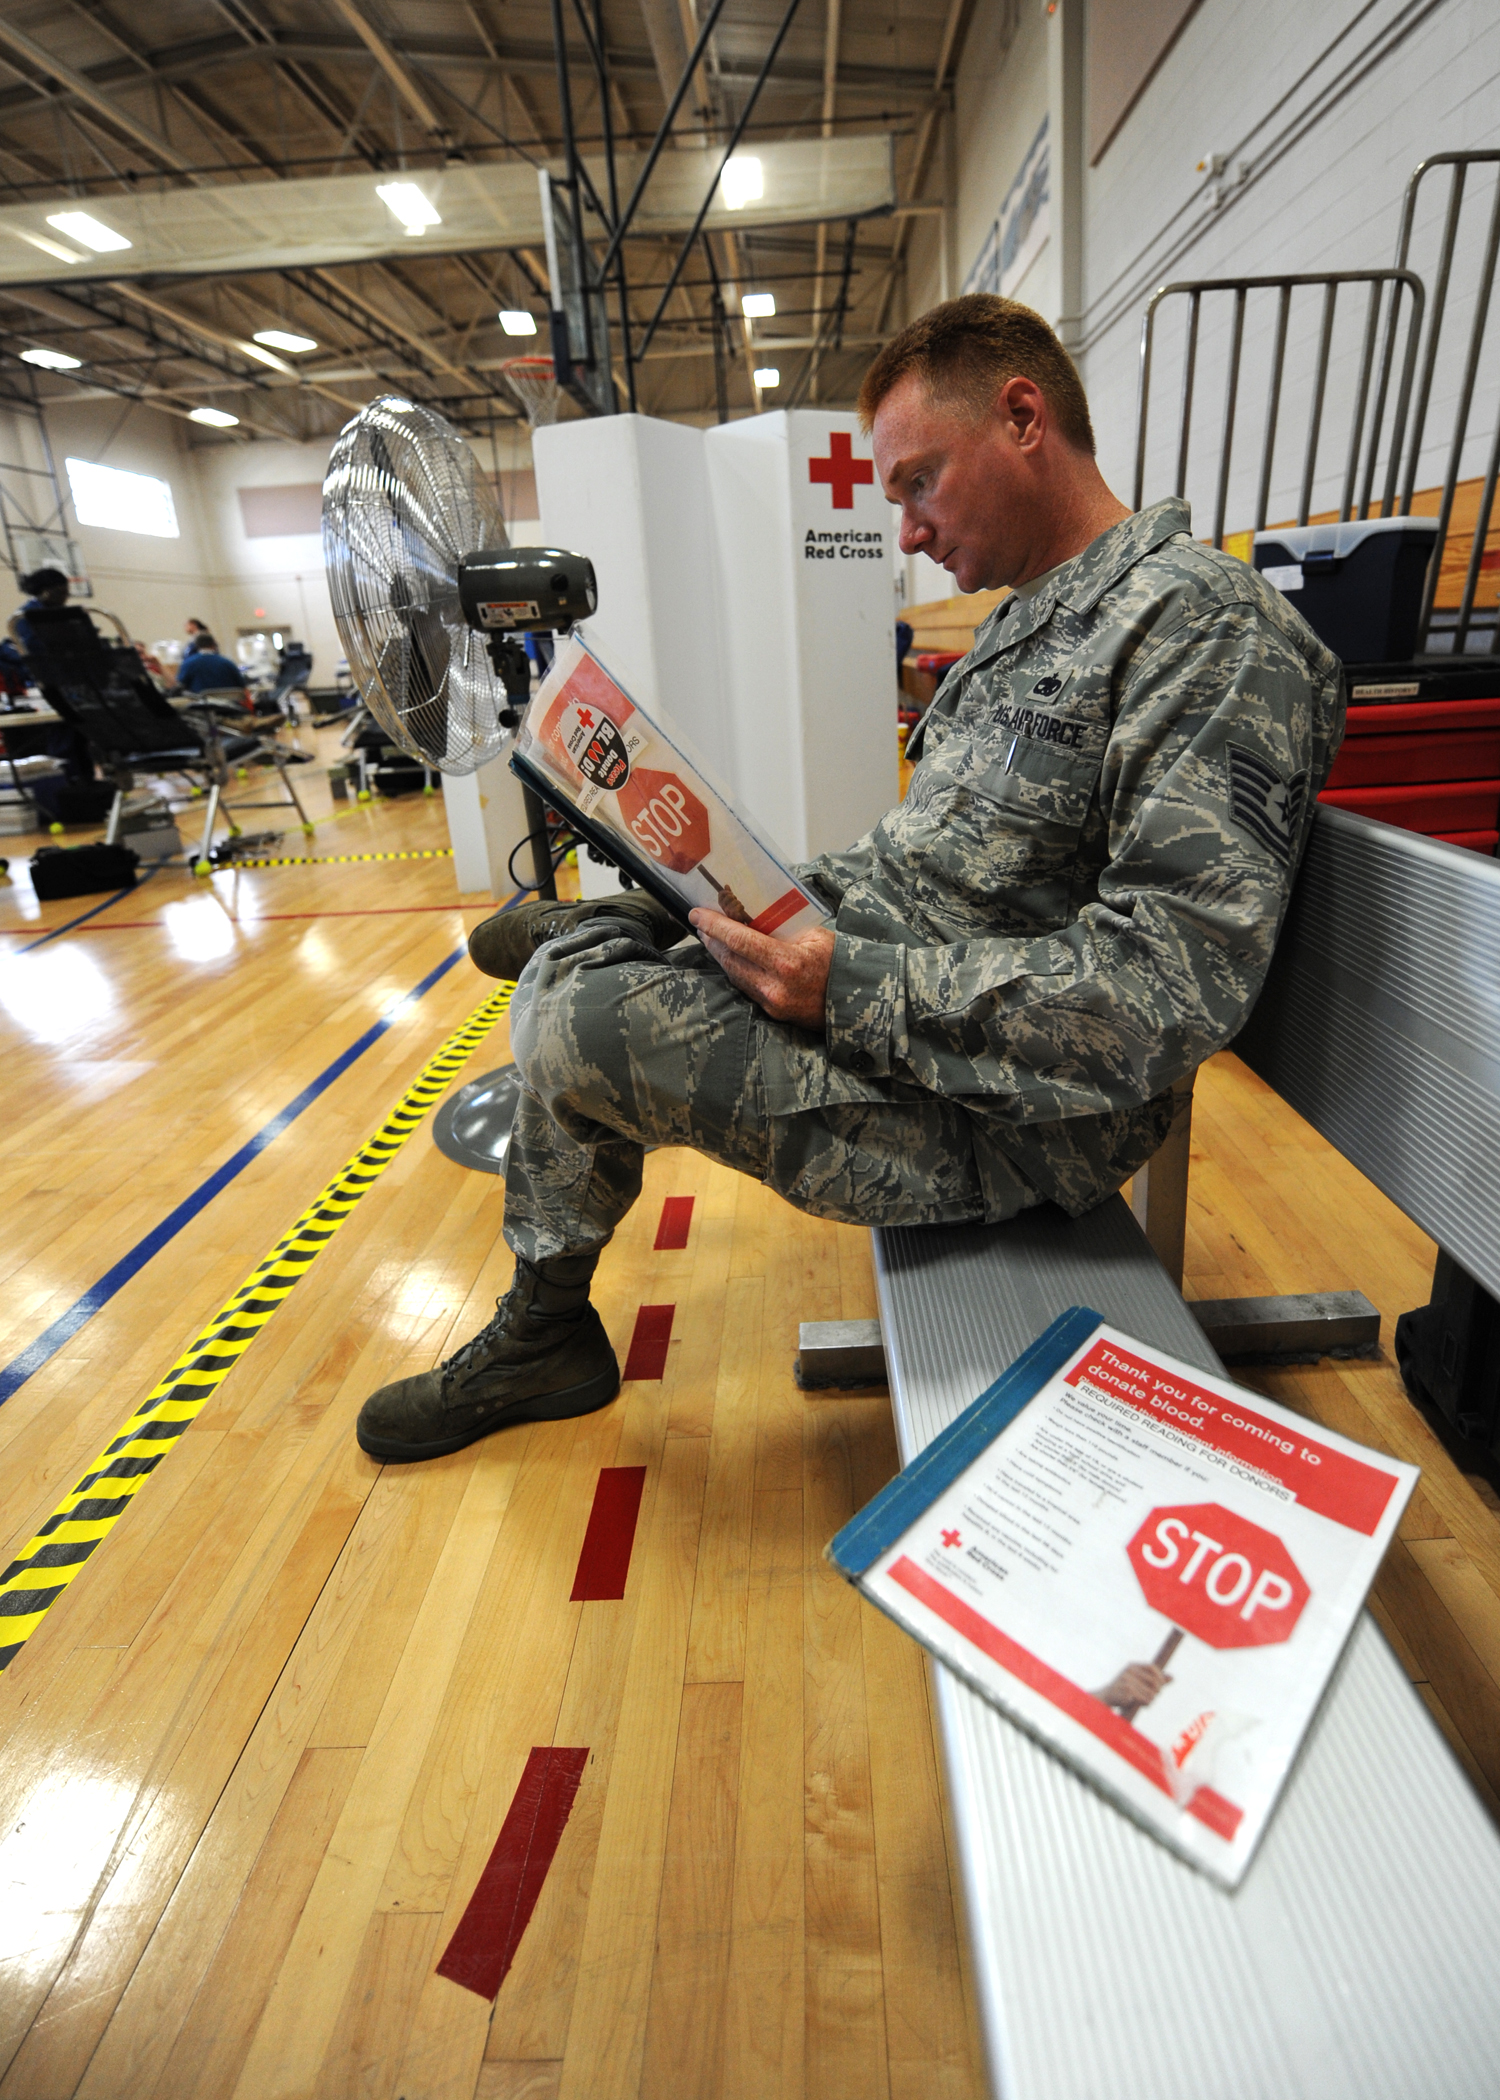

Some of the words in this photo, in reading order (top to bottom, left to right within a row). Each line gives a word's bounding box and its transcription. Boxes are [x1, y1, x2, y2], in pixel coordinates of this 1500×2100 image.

[804, 545, 835, 559] Red
[840, 545, 883, 559] Cross
[805, 529, 882, 543] American
[572, 732, 586, 754] American
[1007, 707, 1034, 732] AIR
[1032, 713, 1088, 748] FORCE
[598, 749, 619, 779] Donate
[606, 758, 627, 787] Please
[631, 783, 692, 857] STOP
[1065, 1392, 1076, 1401] We
[1077, 1400, 1096, 1413] value
[1096, 1411, 1114, 1422] your
[1088, 1365, 1146, 1399] donate
[1150, 1394, 1204, 1430] blood.
[1101, 1349, 1150, 1383] Thank
[1152, 1379, 1187, 1401] you
[1190, 1395, 1218, 1414] for
[1221, 1413, 1295, 1454] coming
[1300, 1447, 1321, 1465] to
[1060, 1397, 1083, 1414] Please
[1084, 1413, 1106, 1427] check
[1107, 1426, 1123, 1436] with
[1131, 1439, 1149, 1450] staff
[1149, 1449, 1182, 1468] member
[1080, 1385, 1140, 1421] REQUIRED
[1141, 1418, 1197, 1452] READING
[1199, 1449, 1228, 1468] FOR
[1229, 1465, 1289, 1500] DONORS
[1143, 1519, 1292, 1619] STOP
